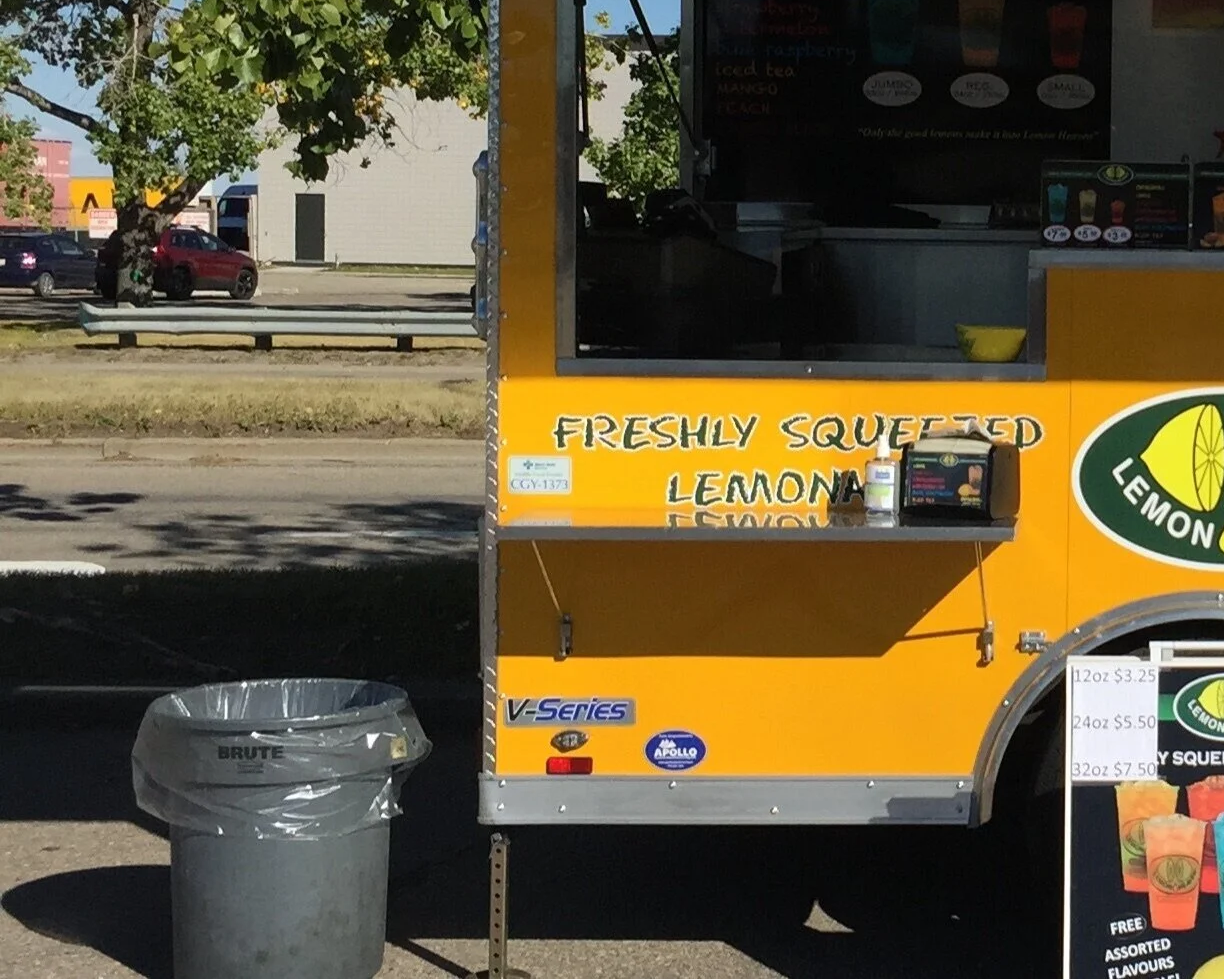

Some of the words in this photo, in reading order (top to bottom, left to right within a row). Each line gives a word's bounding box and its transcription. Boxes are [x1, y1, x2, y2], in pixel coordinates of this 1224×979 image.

[715, 59, 757, 76] iced
[766, 61, 797, 77] tea
[553, 415, 758, 449] FRESHLY
[510, 479, 568, 490] CGY-1373
[1112, 457, 1215, 549] LEMON
[1074, 669, 1109, 683] 12oz
[1114, 668, 1156, 684] $3.25
[1073, 715, 1109, 729] 24oz
[1114, 714, 1156, 730] $5.50
[218, 745, 284, 760] BRUTE
[654, 747, 698, 758] APOLLO
[1072, 762, 1108, 777] 32oz
[1114, 761, 1156, 778] $7.50
[1110, 917, 1143, 935] FREE
[1105, 938, 1171, 963] ASSORTED
[1108, 955, 1175, 979] FLAVOURS
